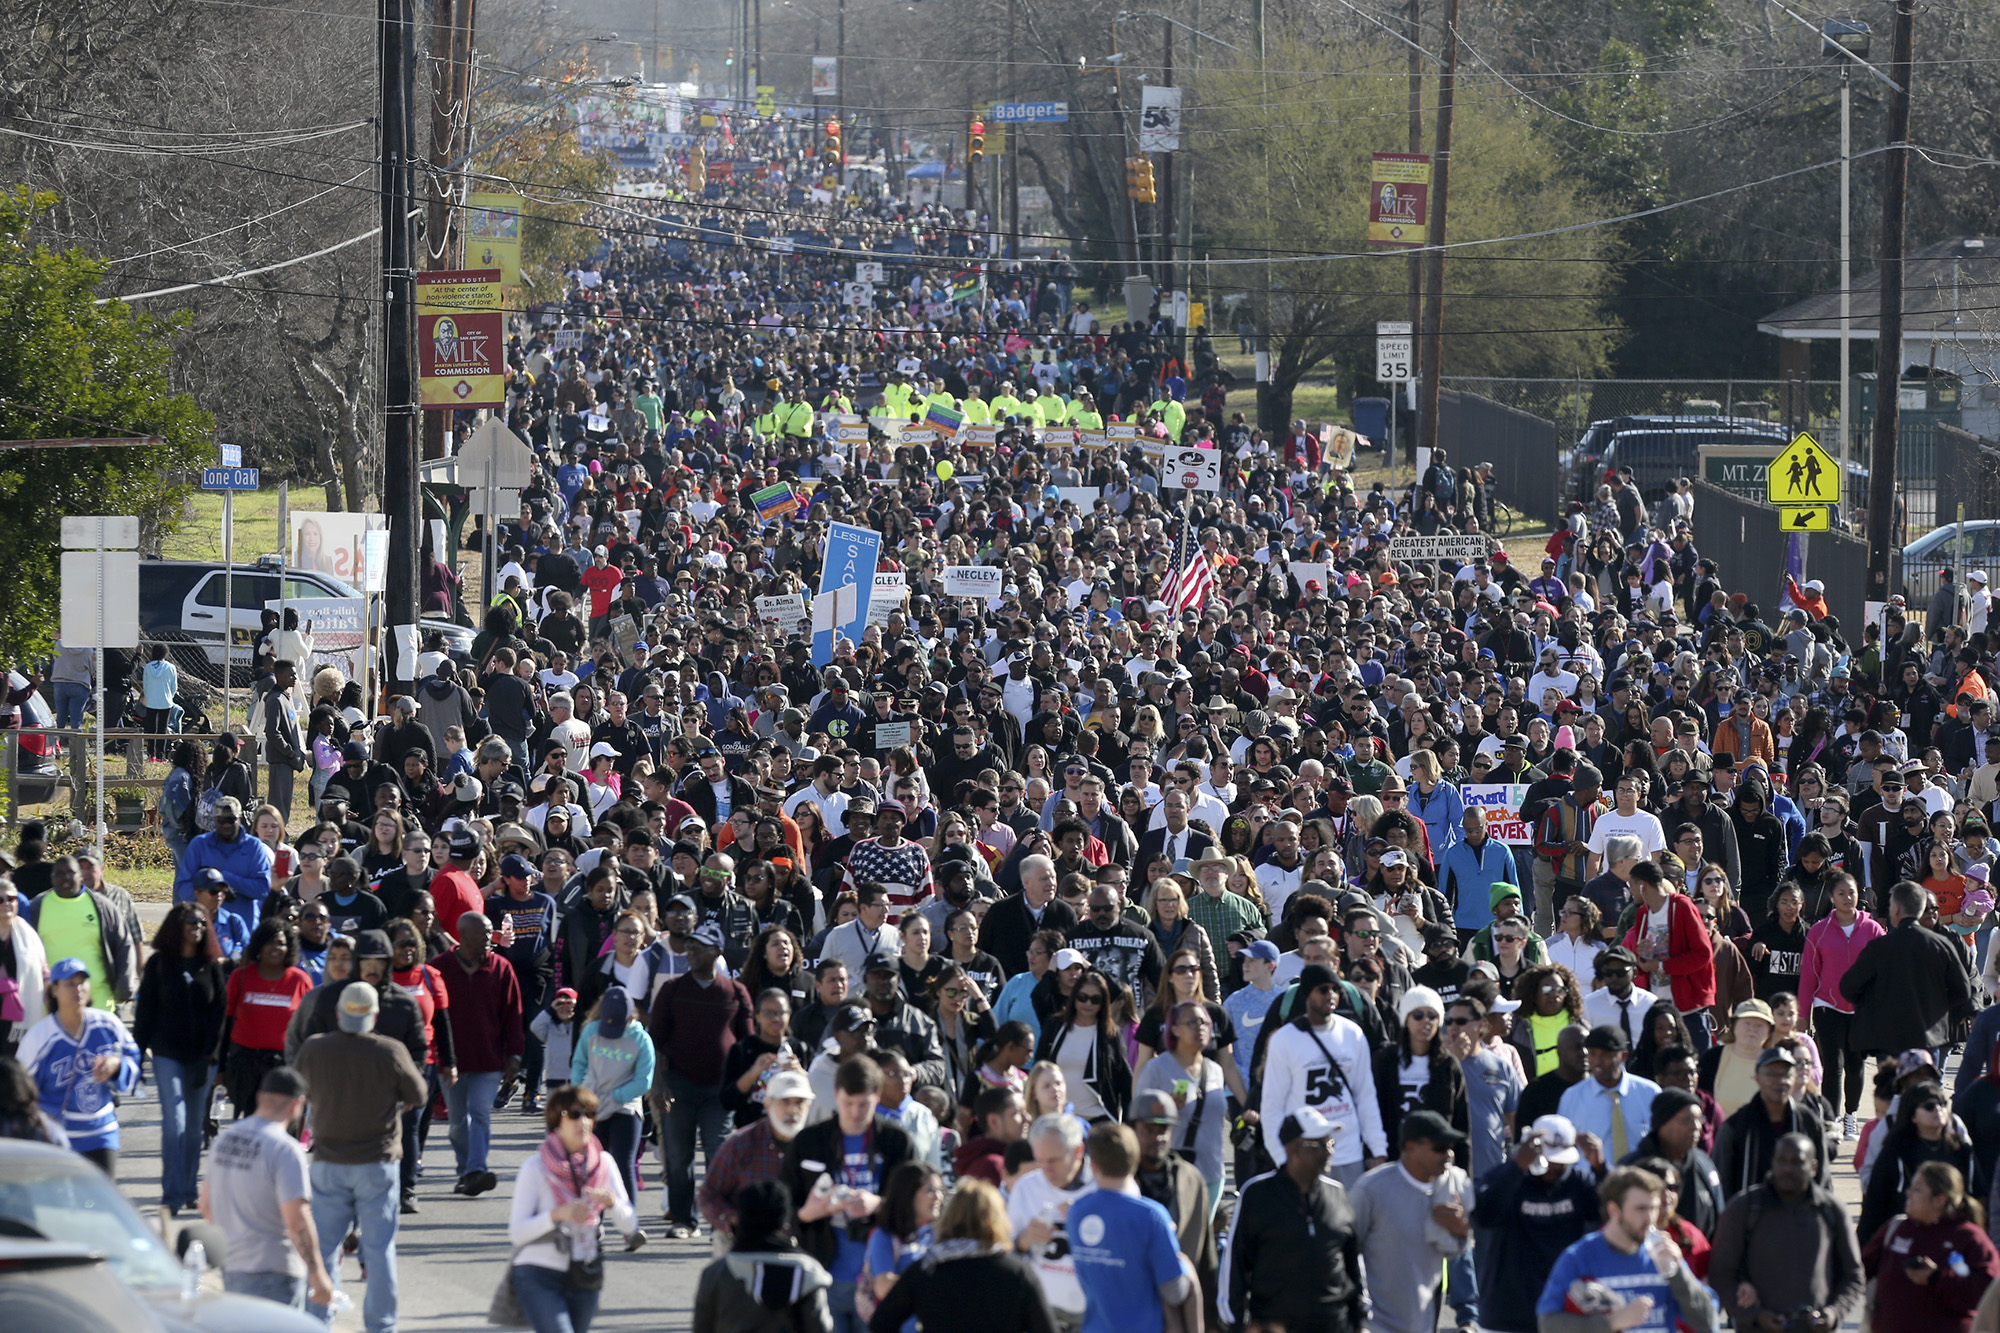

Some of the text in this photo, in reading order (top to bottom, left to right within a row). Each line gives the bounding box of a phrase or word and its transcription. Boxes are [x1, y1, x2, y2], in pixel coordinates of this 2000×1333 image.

[996, 103, 1053, 121] Badger
[1380, 199, 1417, 216] MLK
[1379, 216, 1416, 224] COMMISSION
[438, 300, 467, 308] principle
[434, 340, 489, 363] MLK
[434, 367, 490, 376] COMMISSION
[1381, 362, 1408, 378] 35
[1166, 458, 1176, 475] 5
[1206, 462, 1217, 479] 5
[1722, 464, 1750, 482] MT.
[204, 470, 256, 486] Lone Oak
[1182, 476, 1198, 484] STOP
[833, 529, 876, 548] LESLIE
[1393, 536, 1484, 548] GREATEST AMERICAN:
[1391, 546, 1485, 559] REV. DR. M.L. KING, JR.
[874, 576, 900, 586] GLEY
[957, 570, 996, 581] NEGLEY
[776, 598, 794, 606] Alma
[1463, 786, 1507, 806] Forward
[1069, 936, 1149, 950] I HAVE A DREAM
